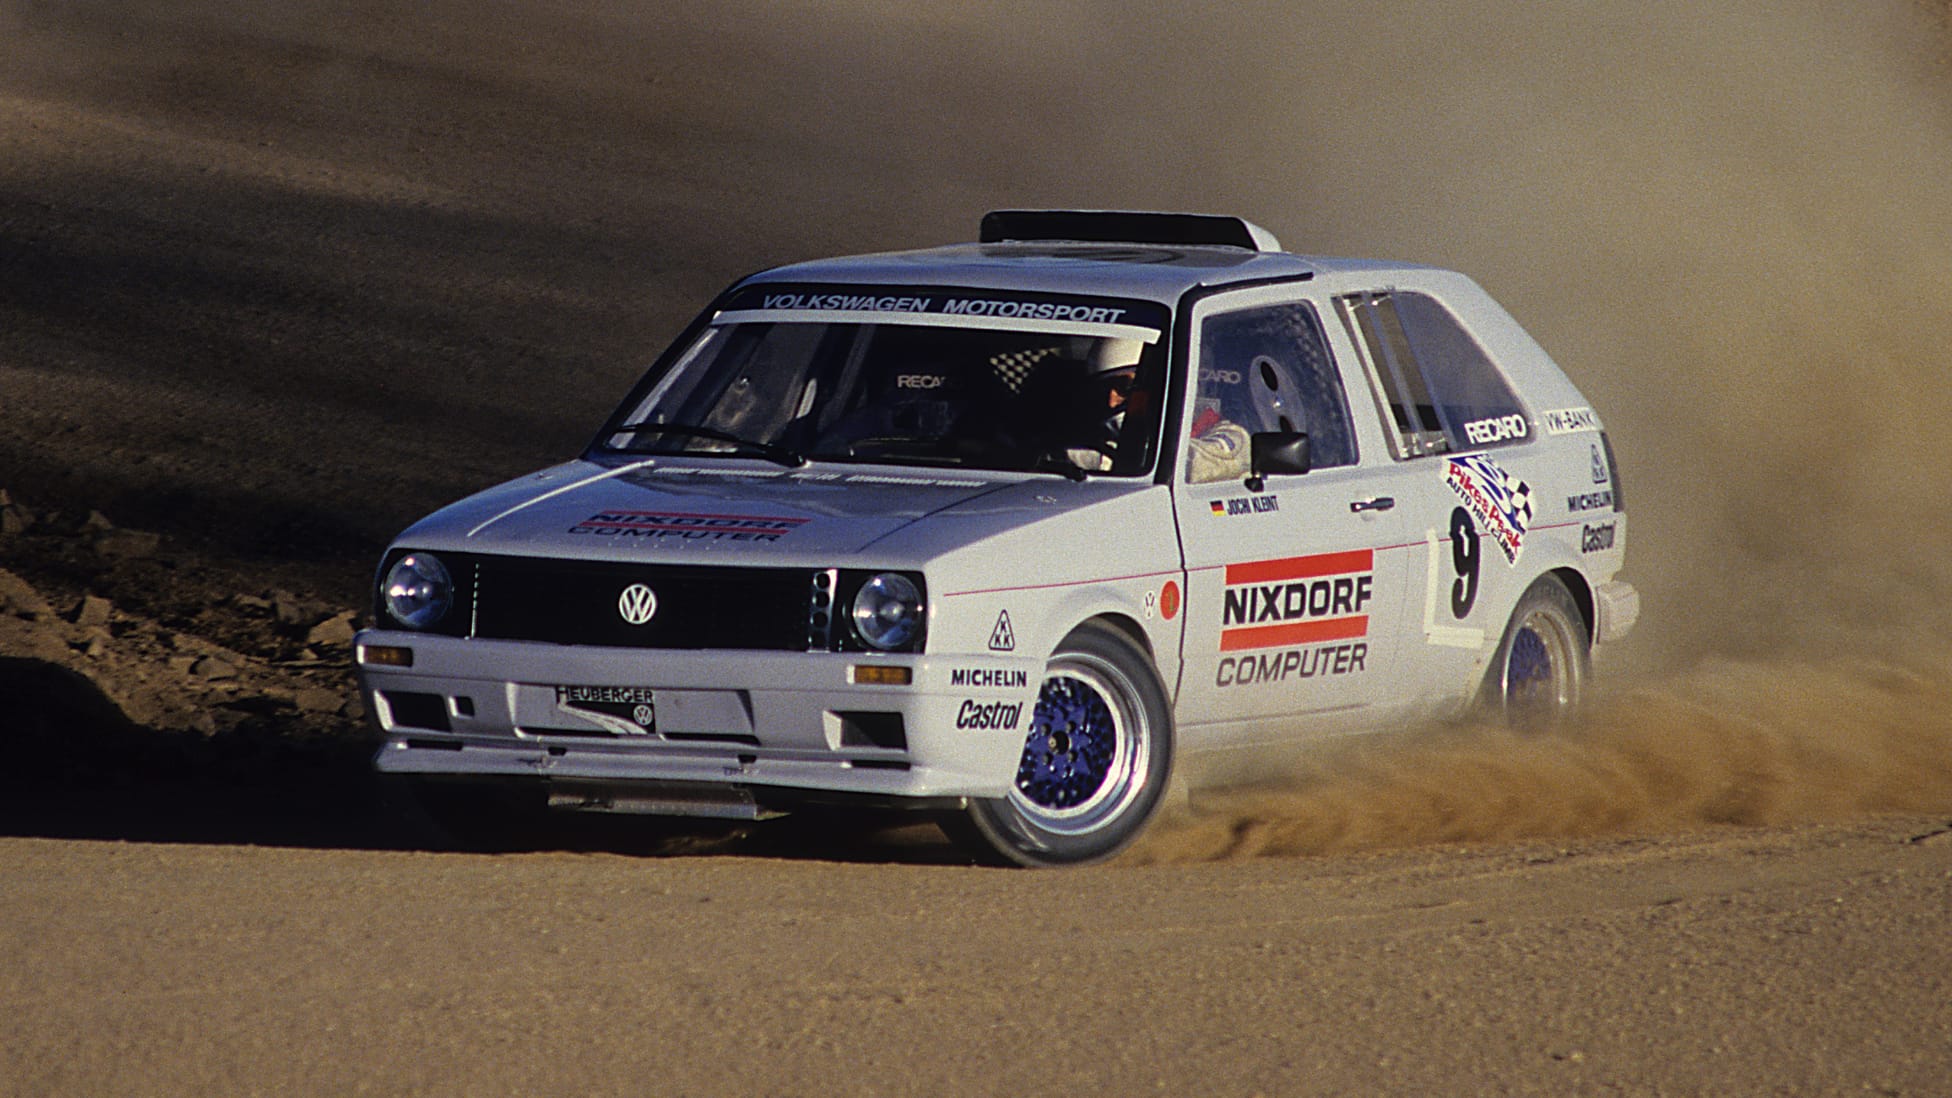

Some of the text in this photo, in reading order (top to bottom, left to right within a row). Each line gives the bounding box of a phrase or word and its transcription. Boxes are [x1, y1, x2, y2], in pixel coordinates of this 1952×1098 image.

[763, 295, 1125, 323] VOLKSWAGEN MOTORSPORT
[897, 374, 946, 388] RECA
[1464, 414, 1528, 444] RECARO
[1446, 477, 1472, 506] AUTO
[1567, 491, 1613, 513] MICHELIN
[567, 526, 781, 542] COMPUTER
[587, 514, 800, 529] NIXDORF
[1582, 520, 1616, 554] Castrol
[1450, 506, 1480, 619] 9
[1223, 575, 1373, 625] NIXDORF
[952, 669, 1027, 687] MICHELIN
[1216, 643, 1368, 687] COMPUTER
[556, 687, 653, 703] HEUBERGER
[957, 699, 1023, 730] Castrol
